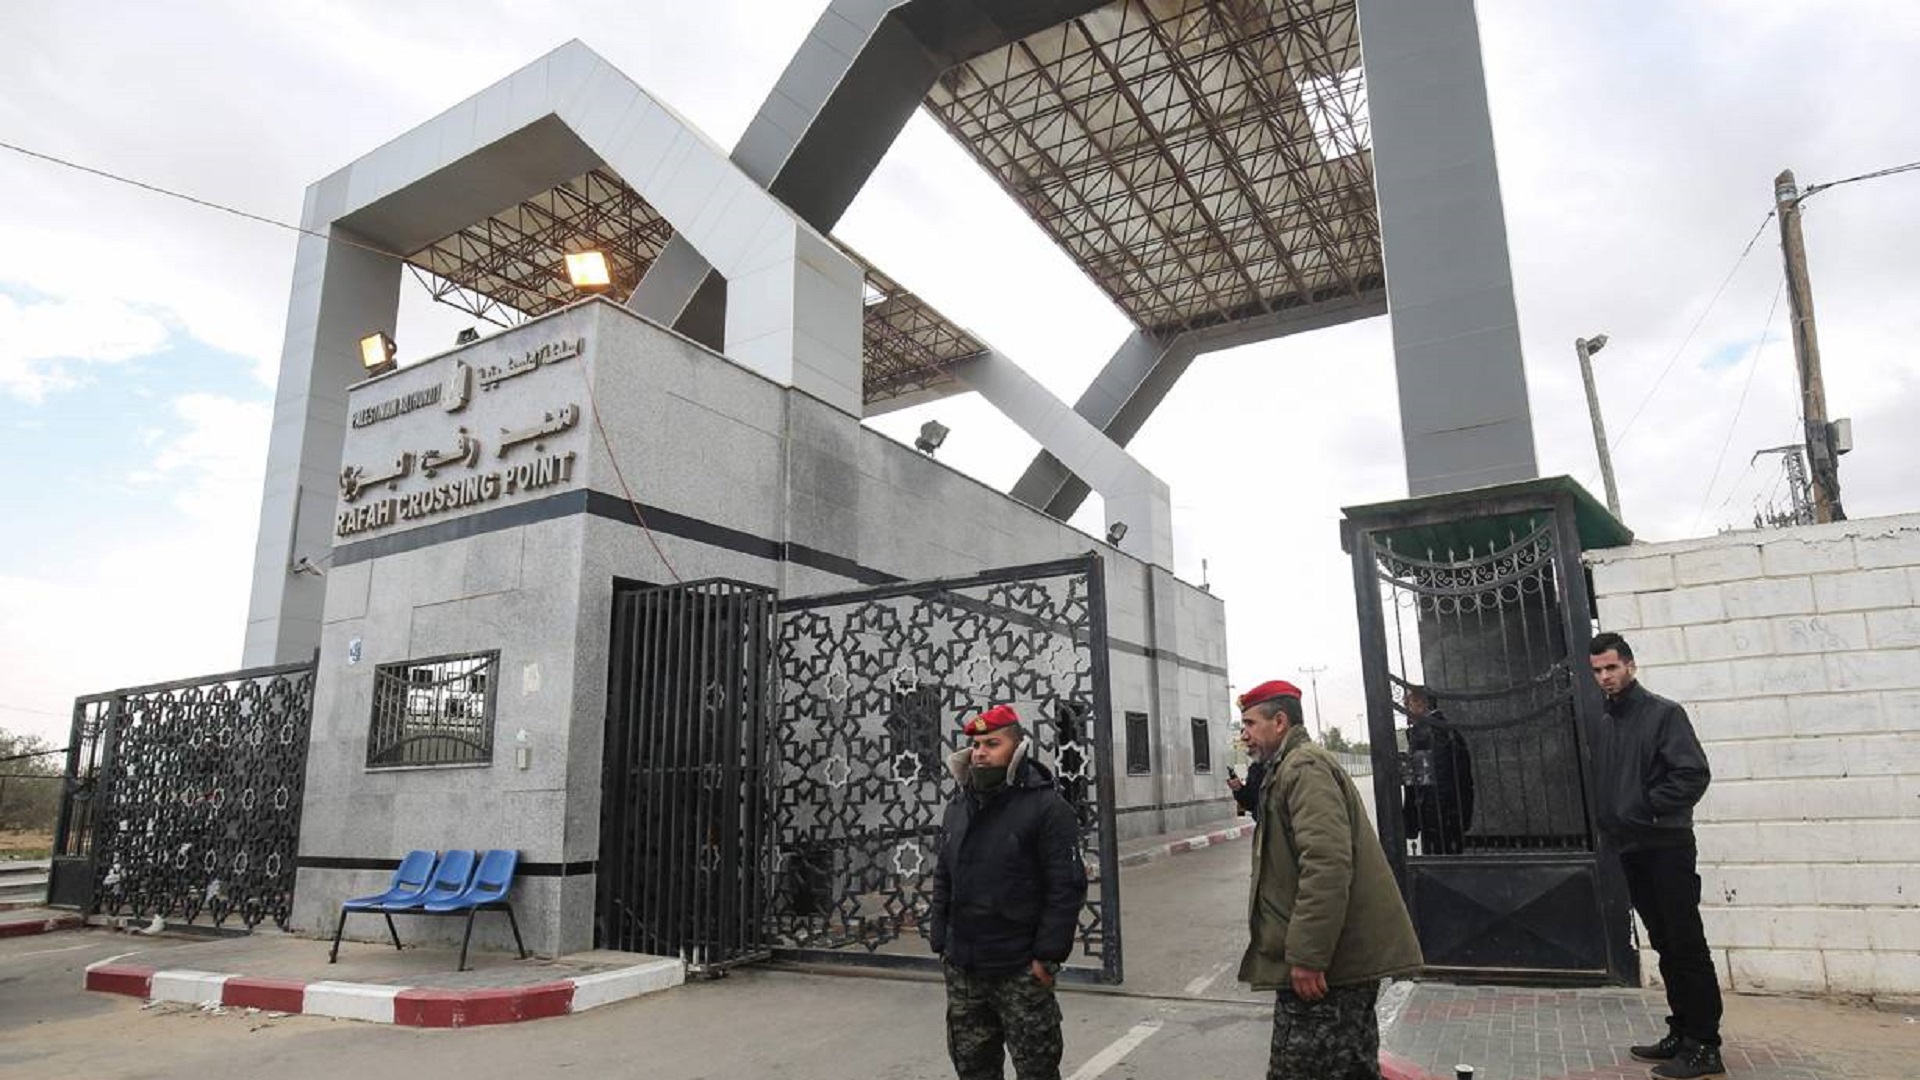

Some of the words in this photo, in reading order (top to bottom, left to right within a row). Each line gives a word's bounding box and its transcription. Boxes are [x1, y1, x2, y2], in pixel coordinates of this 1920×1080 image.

[420, 425, 480, 479] رفح
[497, 402, 579, 459] معبر
[336, 498, 397, 536] RAFAH
[397, 472, 502, 521] CROSSING
[502, 451, 576, 496] POINT
[338, 449, 417, 502] البري
